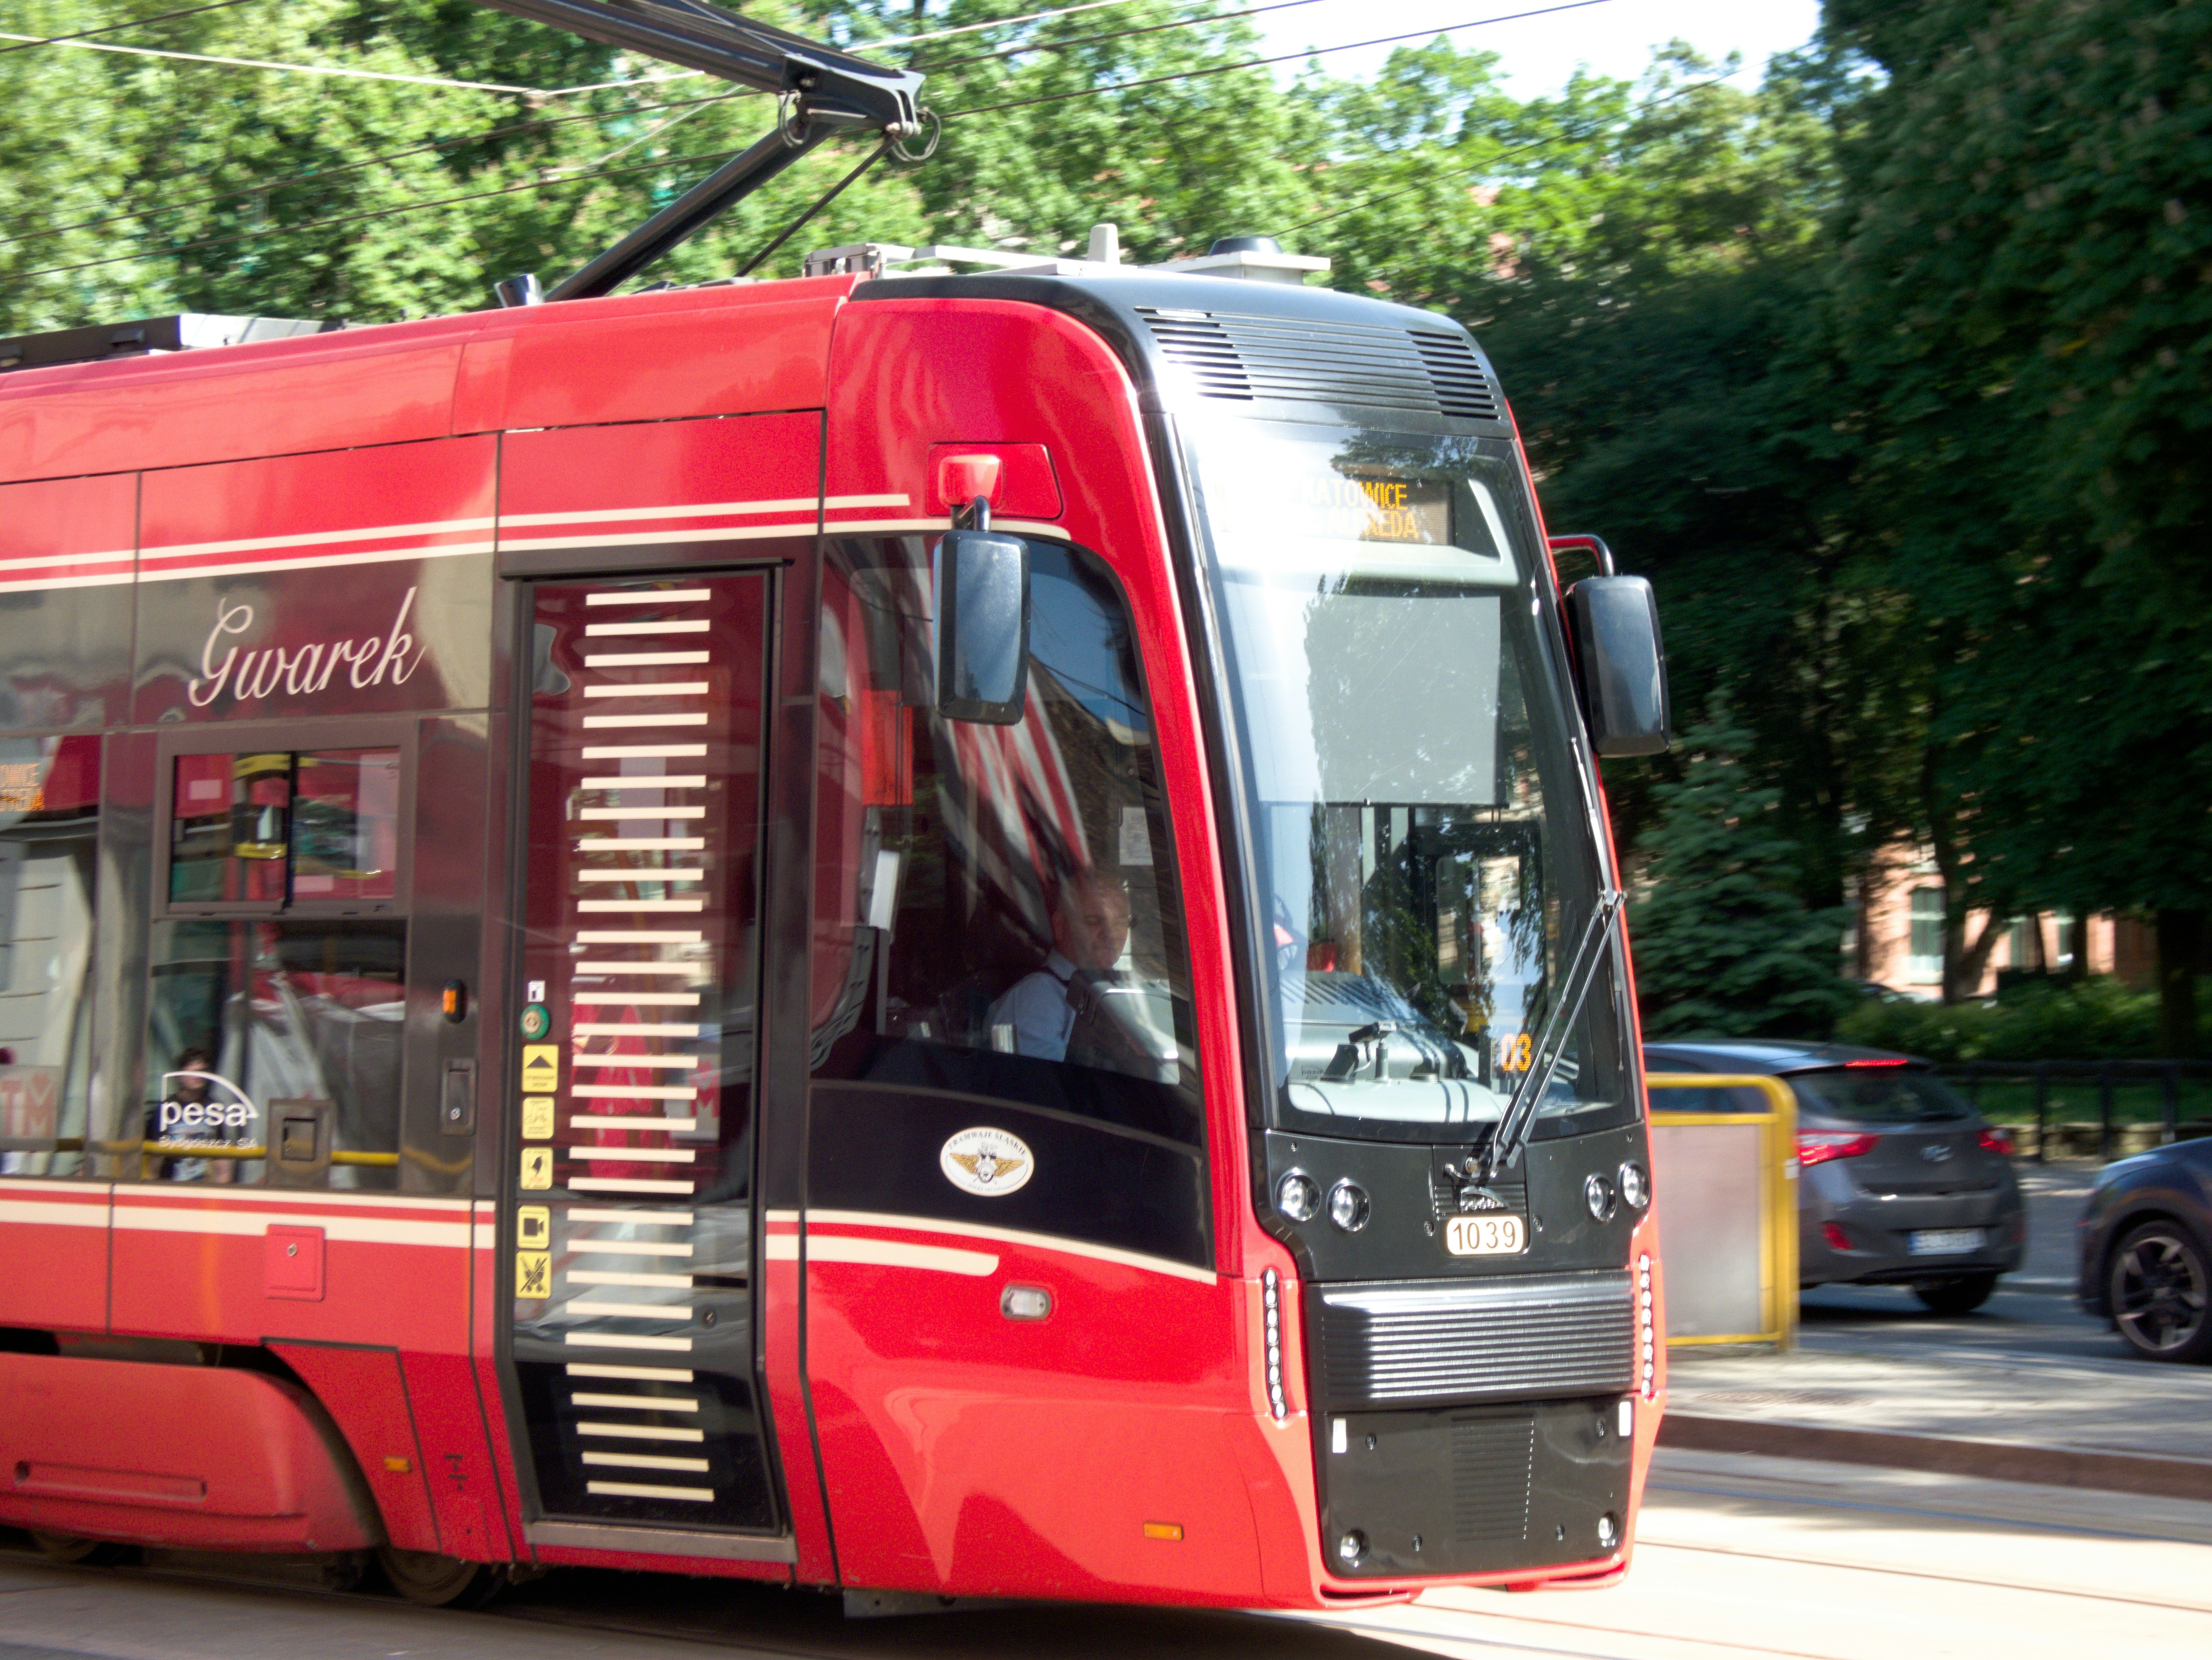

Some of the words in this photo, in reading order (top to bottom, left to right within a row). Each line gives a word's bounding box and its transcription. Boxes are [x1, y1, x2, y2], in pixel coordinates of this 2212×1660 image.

[188, 586, 425, 707] Gwarek
[1501, 1033, 1532, 1071] 03
[159, 1101, 248, 1132] pesa
[1453, 1221, 1516, 1250] 1039
